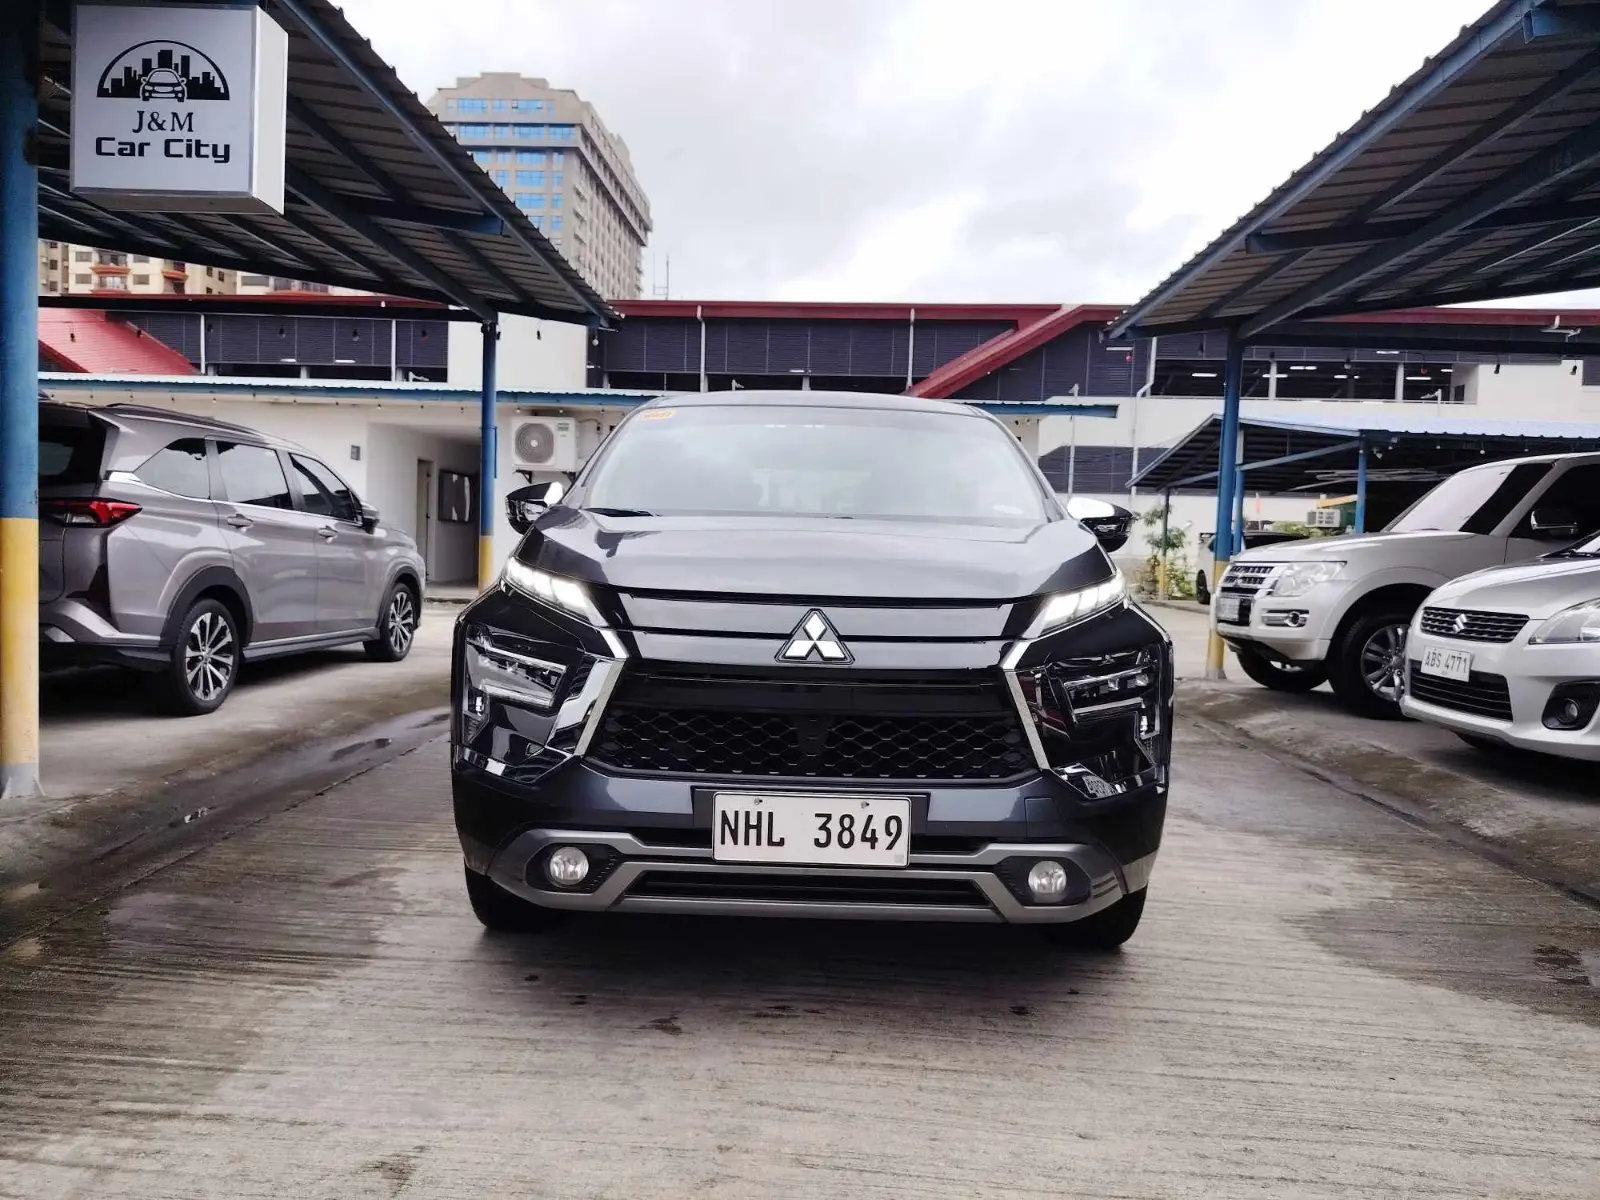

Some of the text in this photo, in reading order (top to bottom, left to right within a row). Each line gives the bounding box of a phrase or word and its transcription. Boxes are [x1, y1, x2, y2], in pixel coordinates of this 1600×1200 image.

[132, 110, 194, 133] J&M
[95, 136, 230, 164] Car City
[1424, 651, 1467, 673] ABS 4771
[720, 809, 902, 851] NHL 3849
